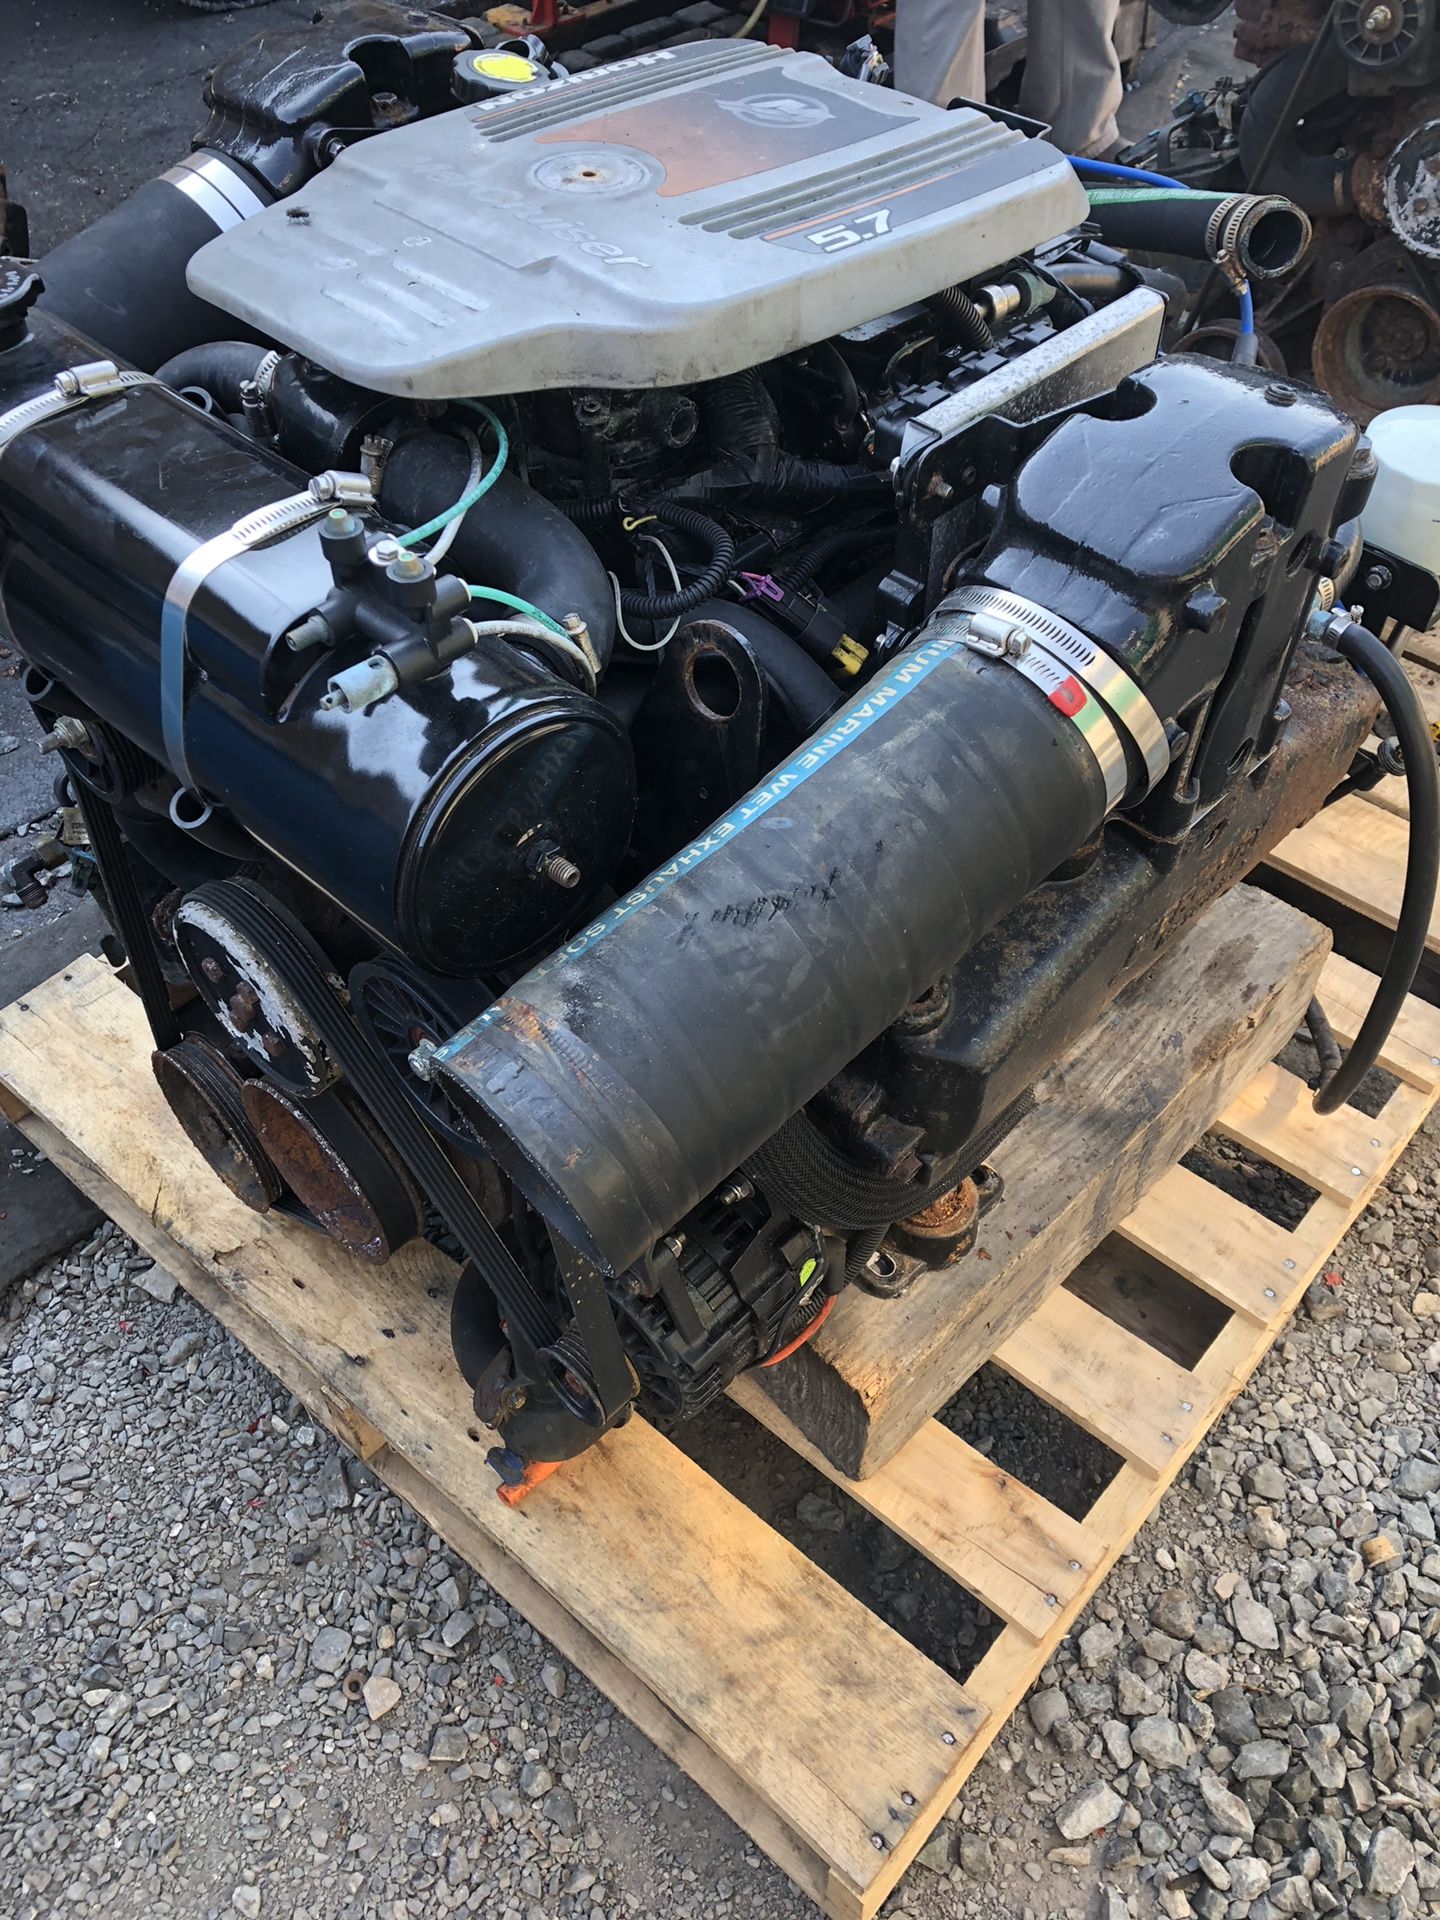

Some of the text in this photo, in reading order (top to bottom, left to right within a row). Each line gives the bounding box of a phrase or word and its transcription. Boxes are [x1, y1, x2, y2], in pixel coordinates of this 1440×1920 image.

[806, 208, 891, 253] 5.7
[894, 640, 955, 685] IUM
[797, 685, 898, 770] MARINE
[739, 772, 799, 820] WET
[613, 821, 736, 919] EXHAUST
